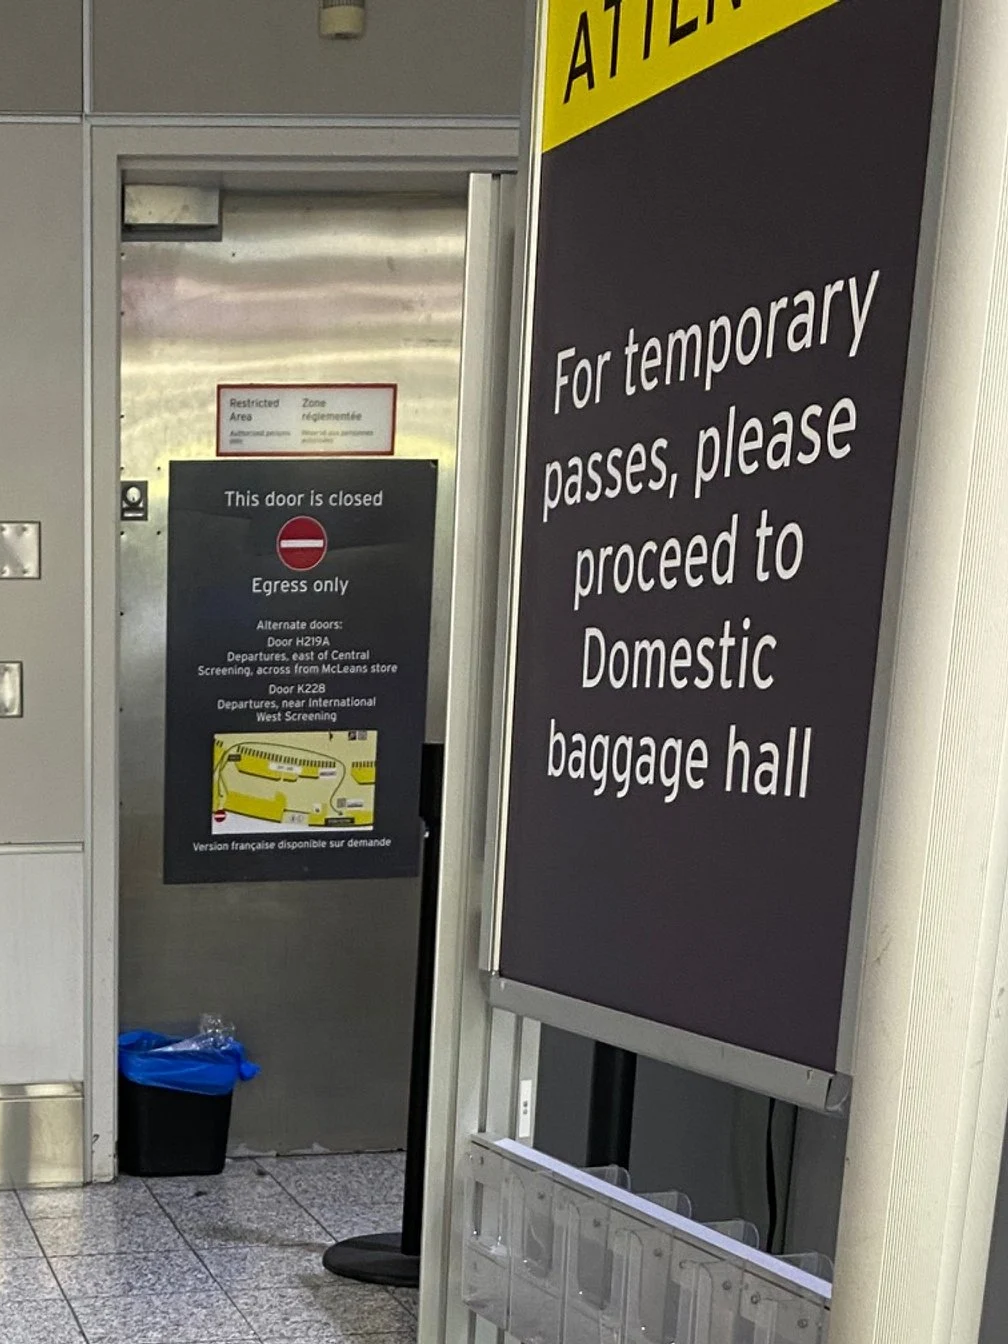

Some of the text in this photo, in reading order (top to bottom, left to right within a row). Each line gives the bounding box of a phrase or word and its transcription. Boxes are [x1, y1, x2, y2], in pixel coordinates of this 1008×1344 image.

[554, 269, 880, 415] For temporary
[229, 398, 280, 408] Restricted
[302, 398, 327, 408] Zone
[229, 412, 252, 422] Area
[543, 397, 858, 523] passes, please
[224, 490, 383, 507] This door is closed
[573, 509, 805, 611] proceed to
[252, 577, 349, 596] Egress only
[256, 620, 344, 630] Alternate doors:
[267, 636, 331, 647] Door H219A
[226, 650, 370, 664] Departures, east of Central
[582, 617, 777, 690] Domestic
[198, 663, 398, 677] Screening, across from McLeans store
[268, 683, 326, 694] Door K228
[217, 697, 377, 711] Departures, near International
[256, 711, 337, 723] West Screening
[547, 718, 812, 803] baggage hall
[193, 837, 392, 852] Version française disponible sur demande
